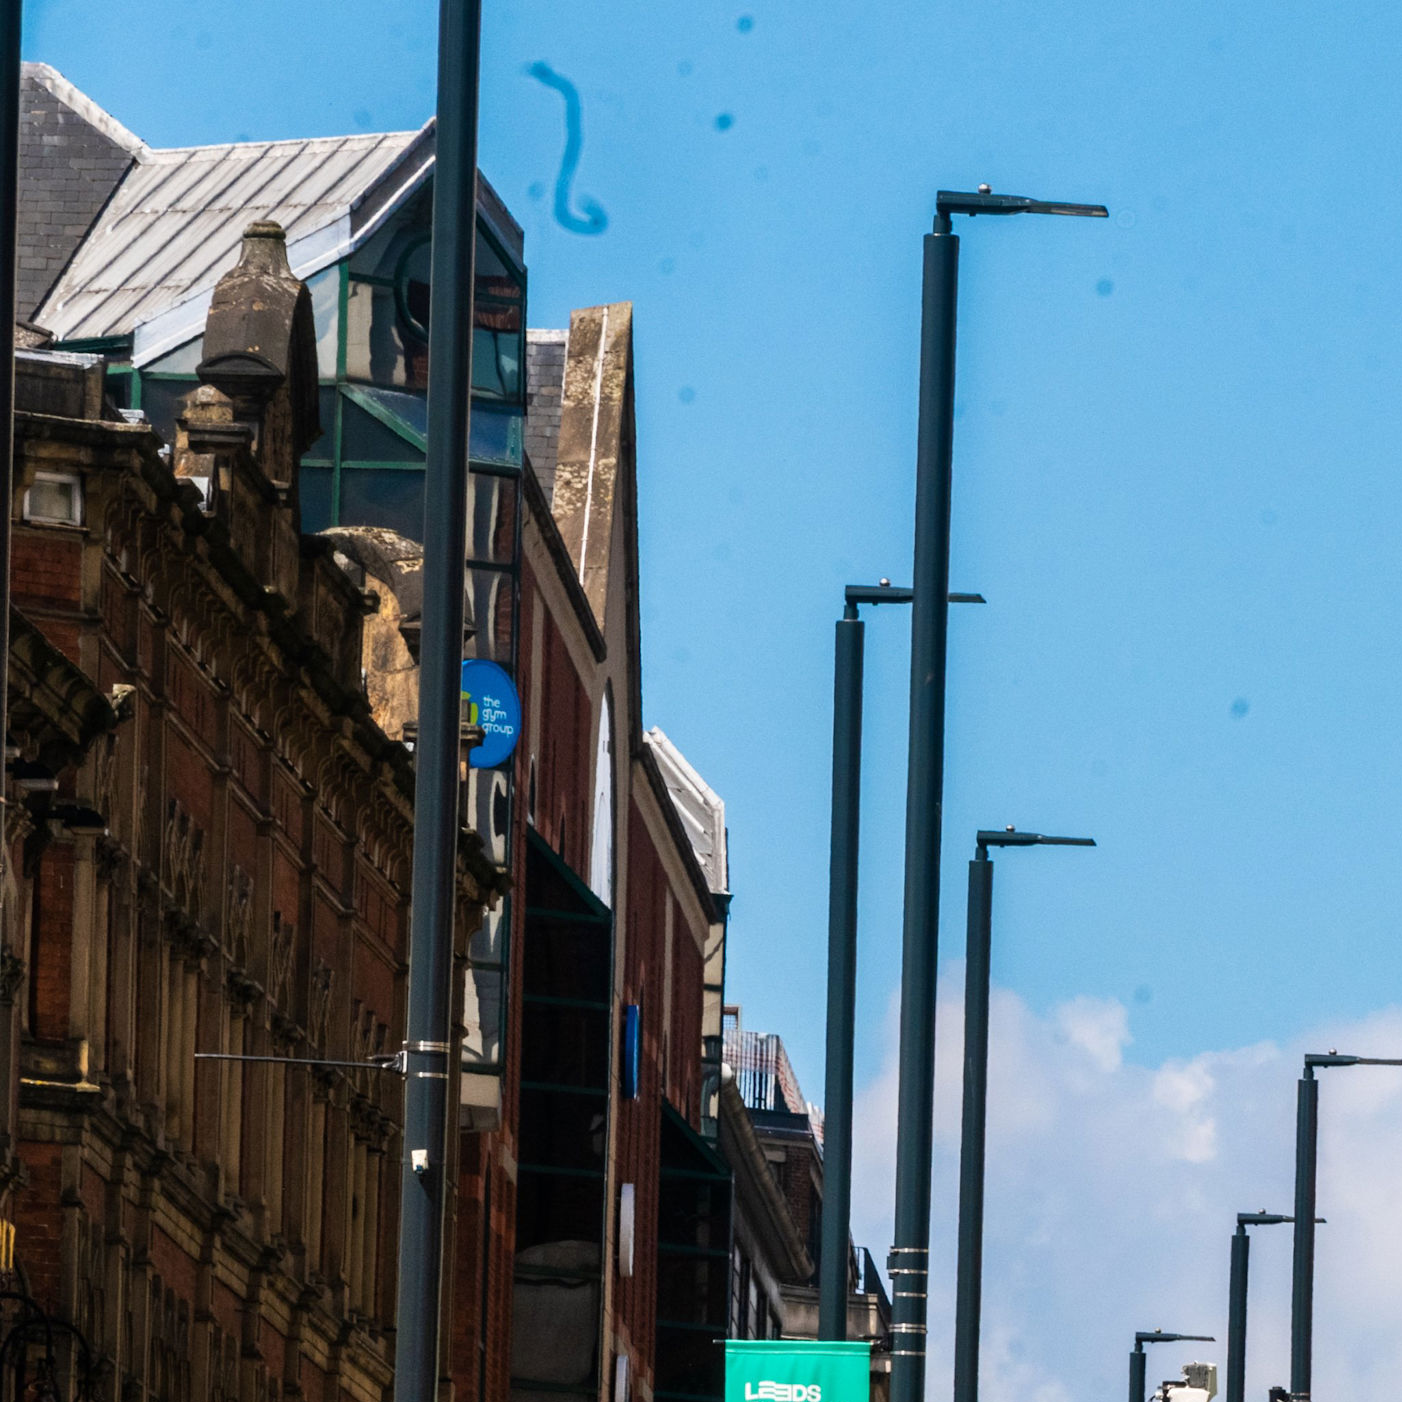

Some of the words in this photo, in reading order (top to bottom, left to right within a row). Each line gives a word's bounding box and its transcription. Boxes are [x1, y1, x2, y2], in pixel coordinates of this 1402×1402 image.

[483, 694, 500, 708] the
[482, 708, 507, 722] gym
[482, 722, 514, 738] group
[744, 1380, 822, 1402] LEEDS
